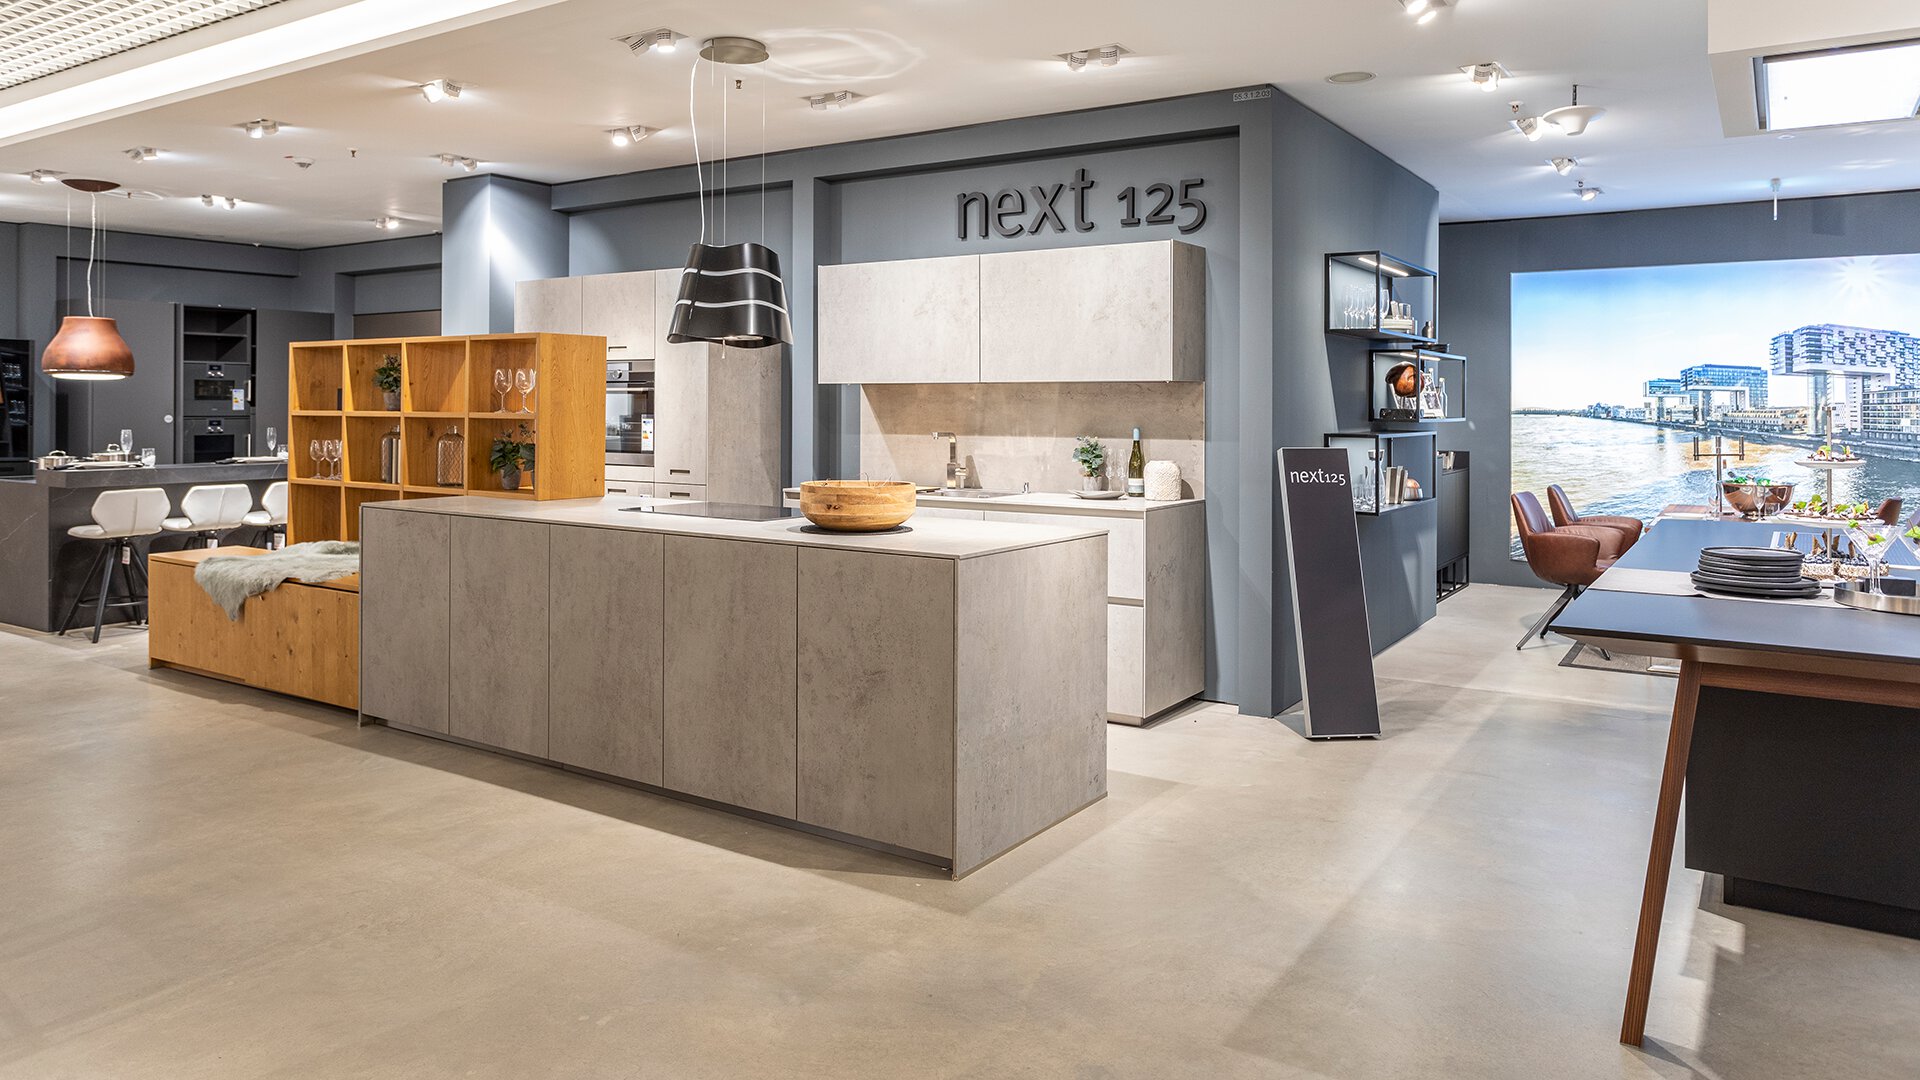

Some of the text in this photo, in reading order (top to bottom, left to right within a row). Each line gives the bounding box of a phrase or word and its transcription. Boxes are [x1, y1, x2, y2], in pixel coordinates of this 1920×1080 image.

[957, 168, 1207, 240] next 125
[1290, 468, 1346, 486] next125
